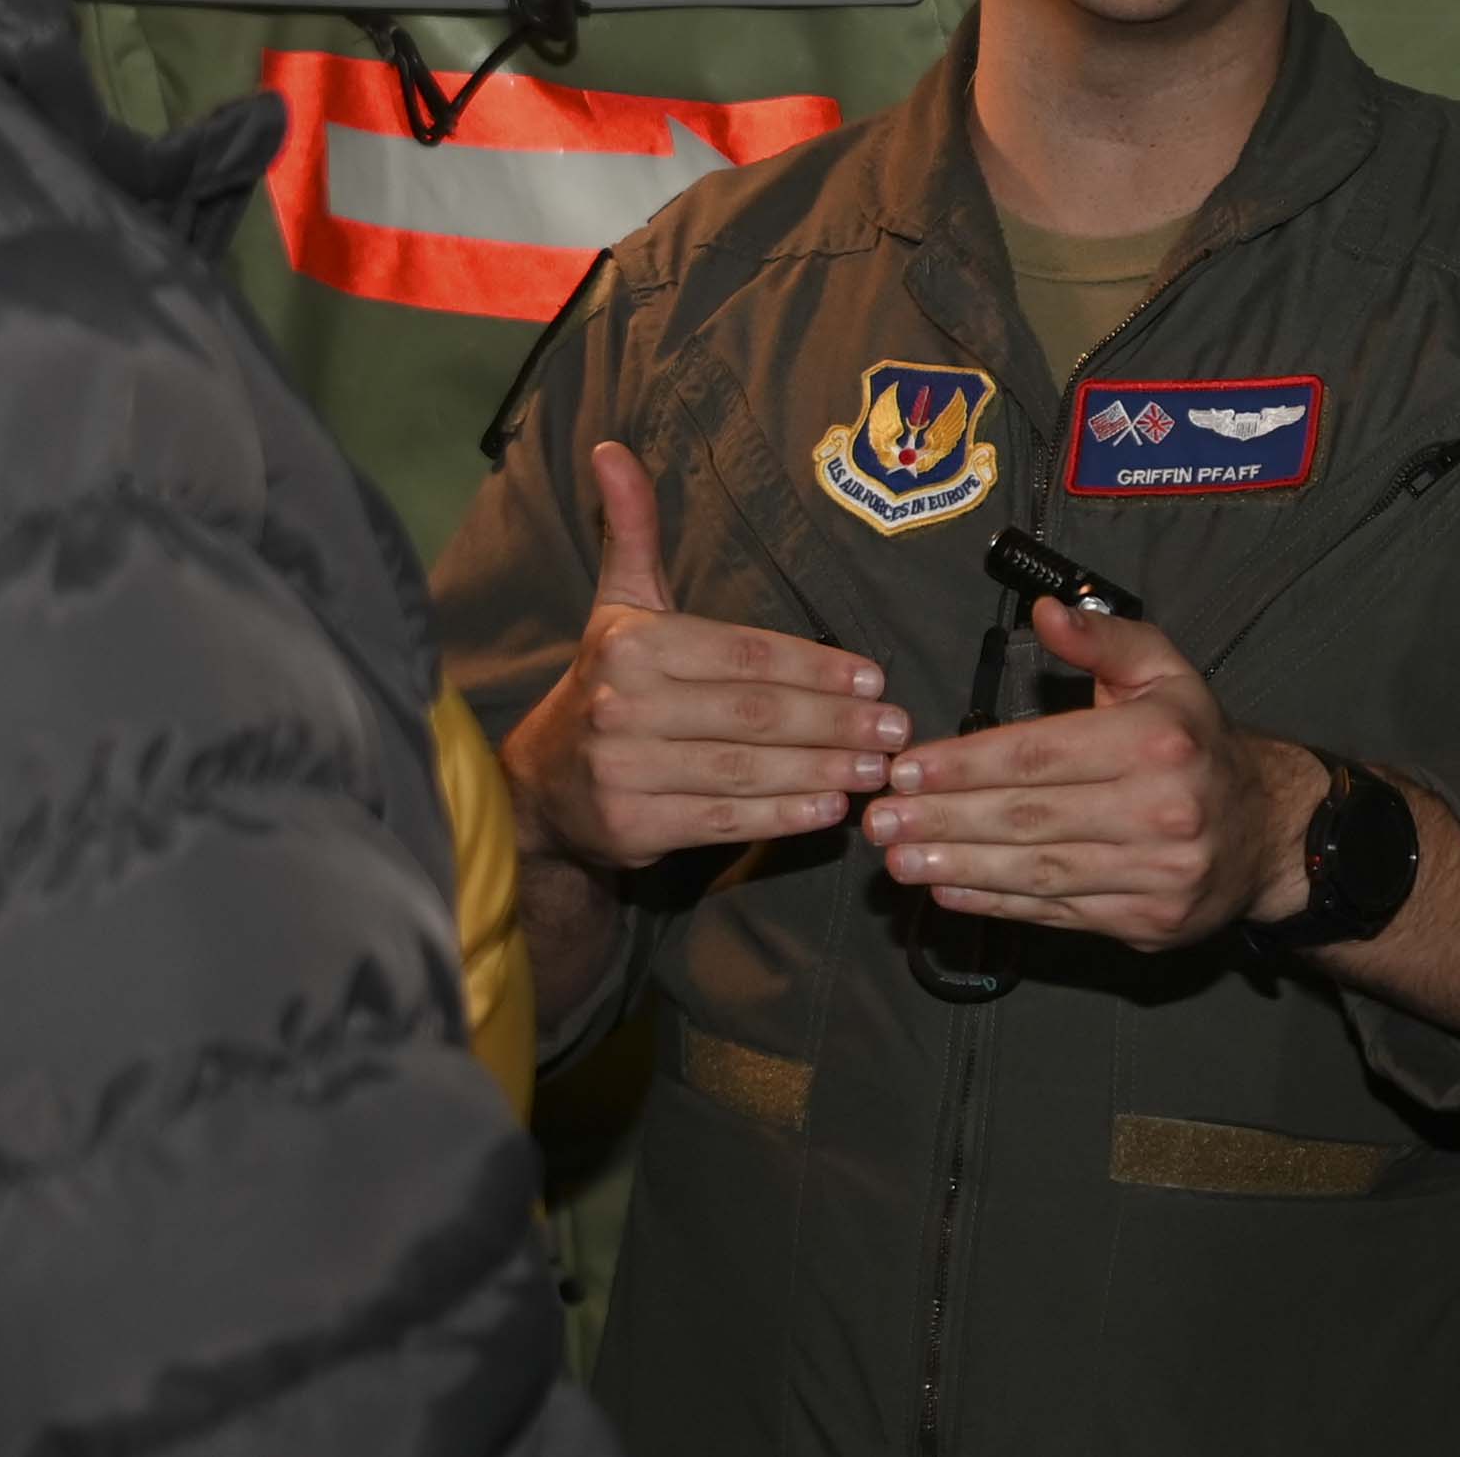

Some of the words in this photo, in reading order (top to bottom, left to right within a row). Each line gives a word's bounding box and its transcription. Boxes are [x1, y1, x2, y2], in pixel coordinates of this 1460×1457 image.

[1116, 466, 1193, 486] GRIFFIN
[1197, 463, 1262, 483] PFAFF
[840, 477, 865, 500] AIR
[861, 490, 910, 522] FORCES
[911, 497, 926, 515] IN
[928, 474, 981, 510] EUROPE
